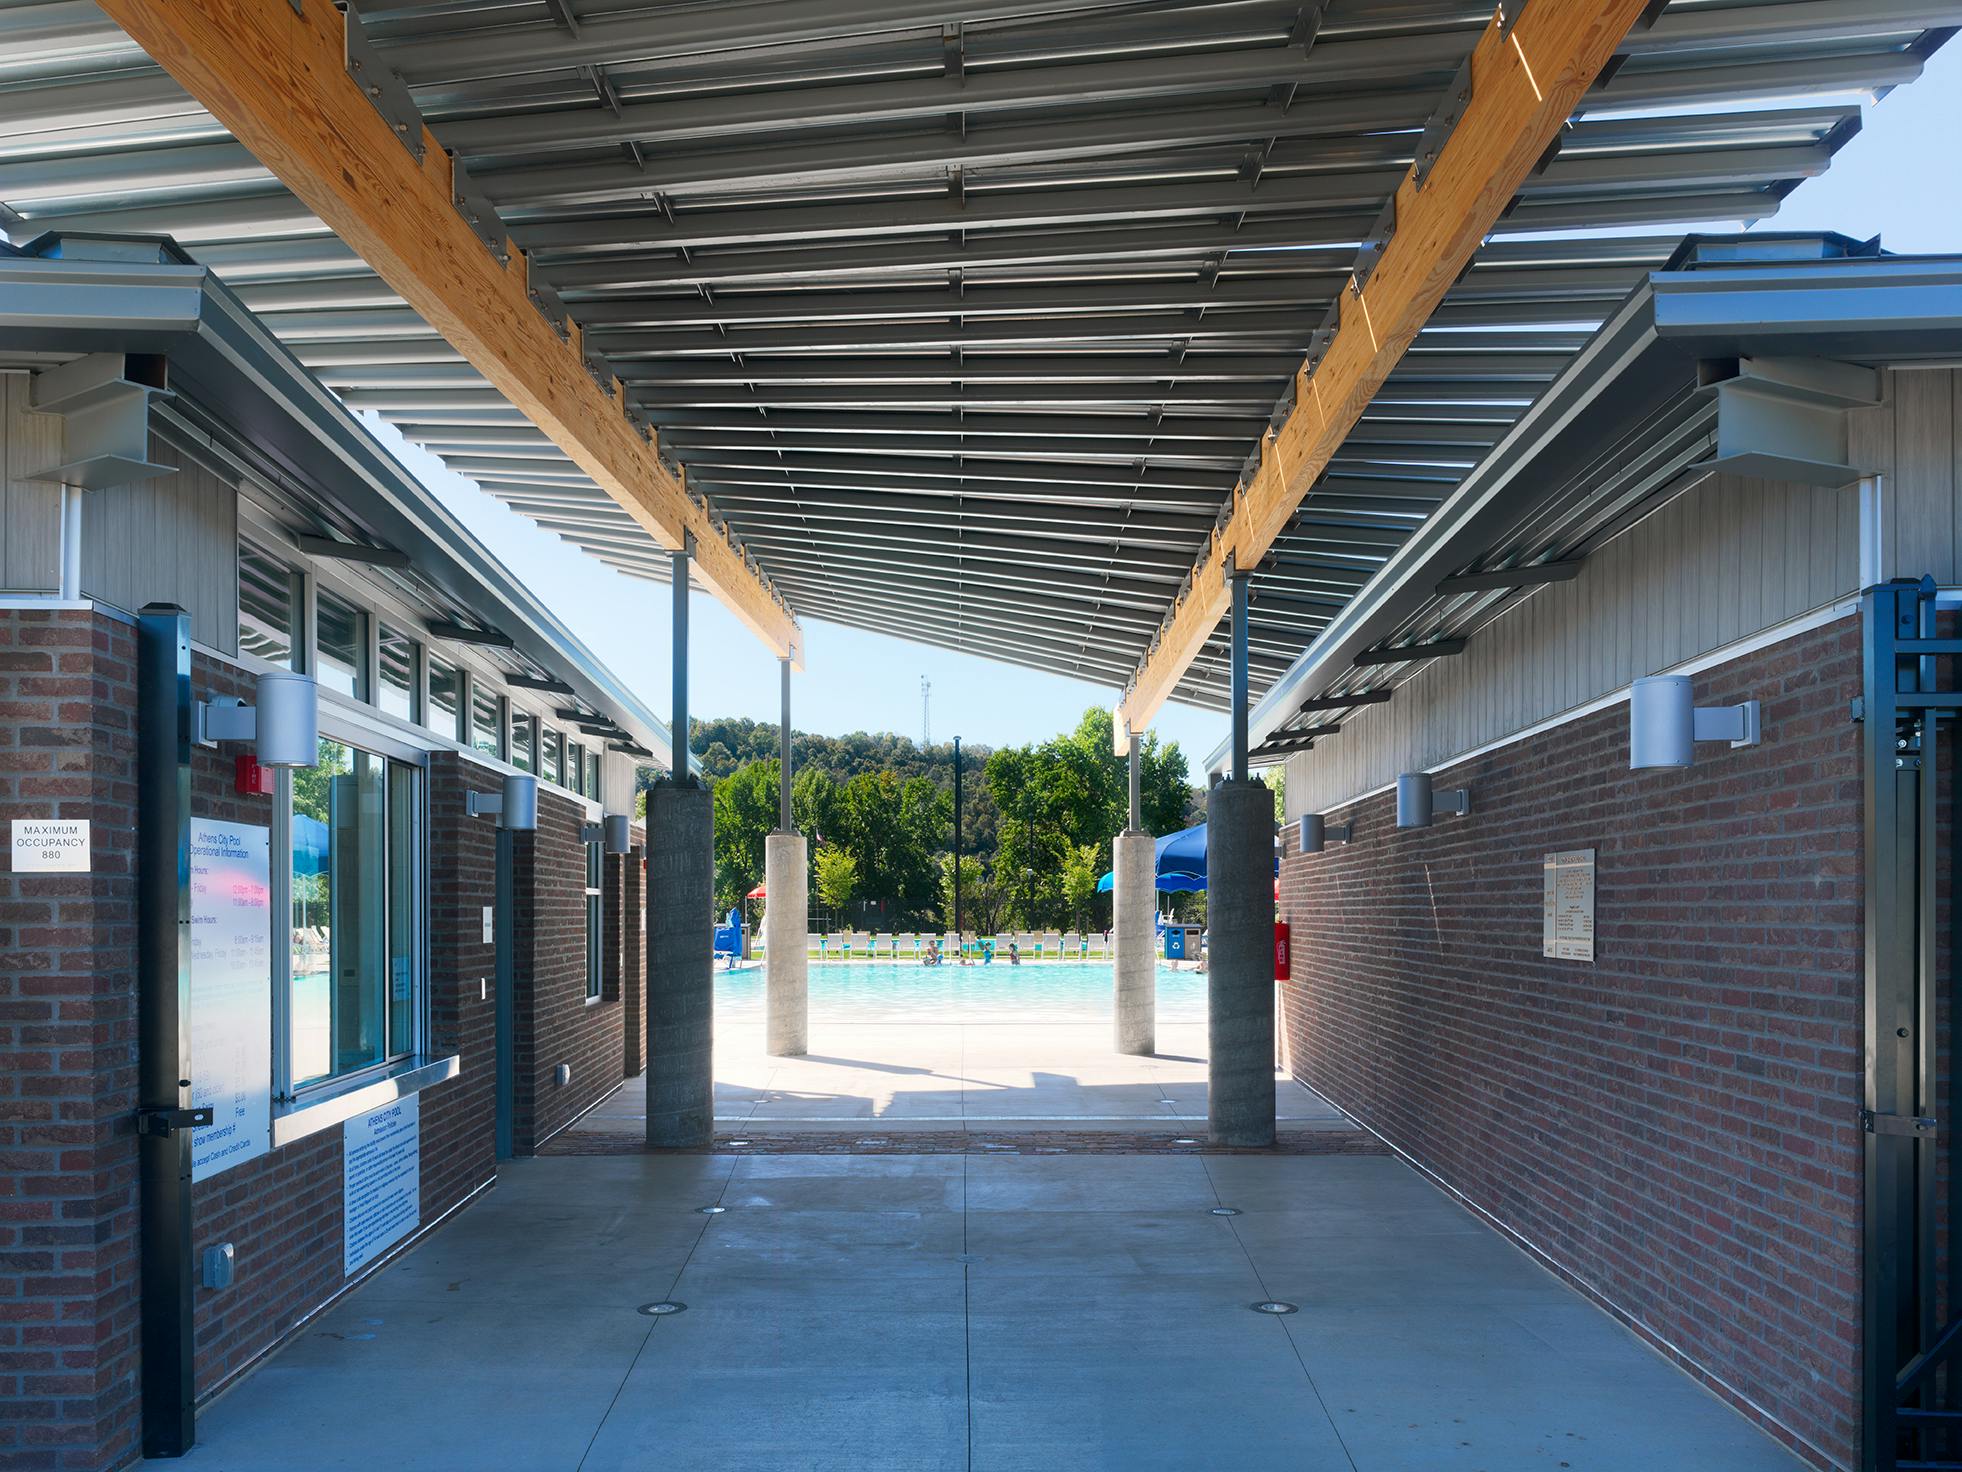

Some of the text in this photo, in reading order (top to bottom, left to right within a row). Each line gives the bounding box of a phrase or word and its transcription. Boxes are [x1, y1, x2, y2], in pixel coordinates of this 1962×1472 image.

[24, 826, 78, 834] MAXIMUM
[16, 838, 86, 847] OCCUPANCY
[198, 832, 240, 847] Athens City Pool
[42, 850, 61, 859] 880
[190, 844, 248, 859] Operational Information
[368, 1113, 383, 1128] ATHENS
[392, 1106, 401, 1117] POOL
[194, 1135, 205, 1147] show
[206, 1125, 233, 1143] membership
[211, 1151, 221, 1161] Cash
[229, 1143, 240, 1154] Credit
